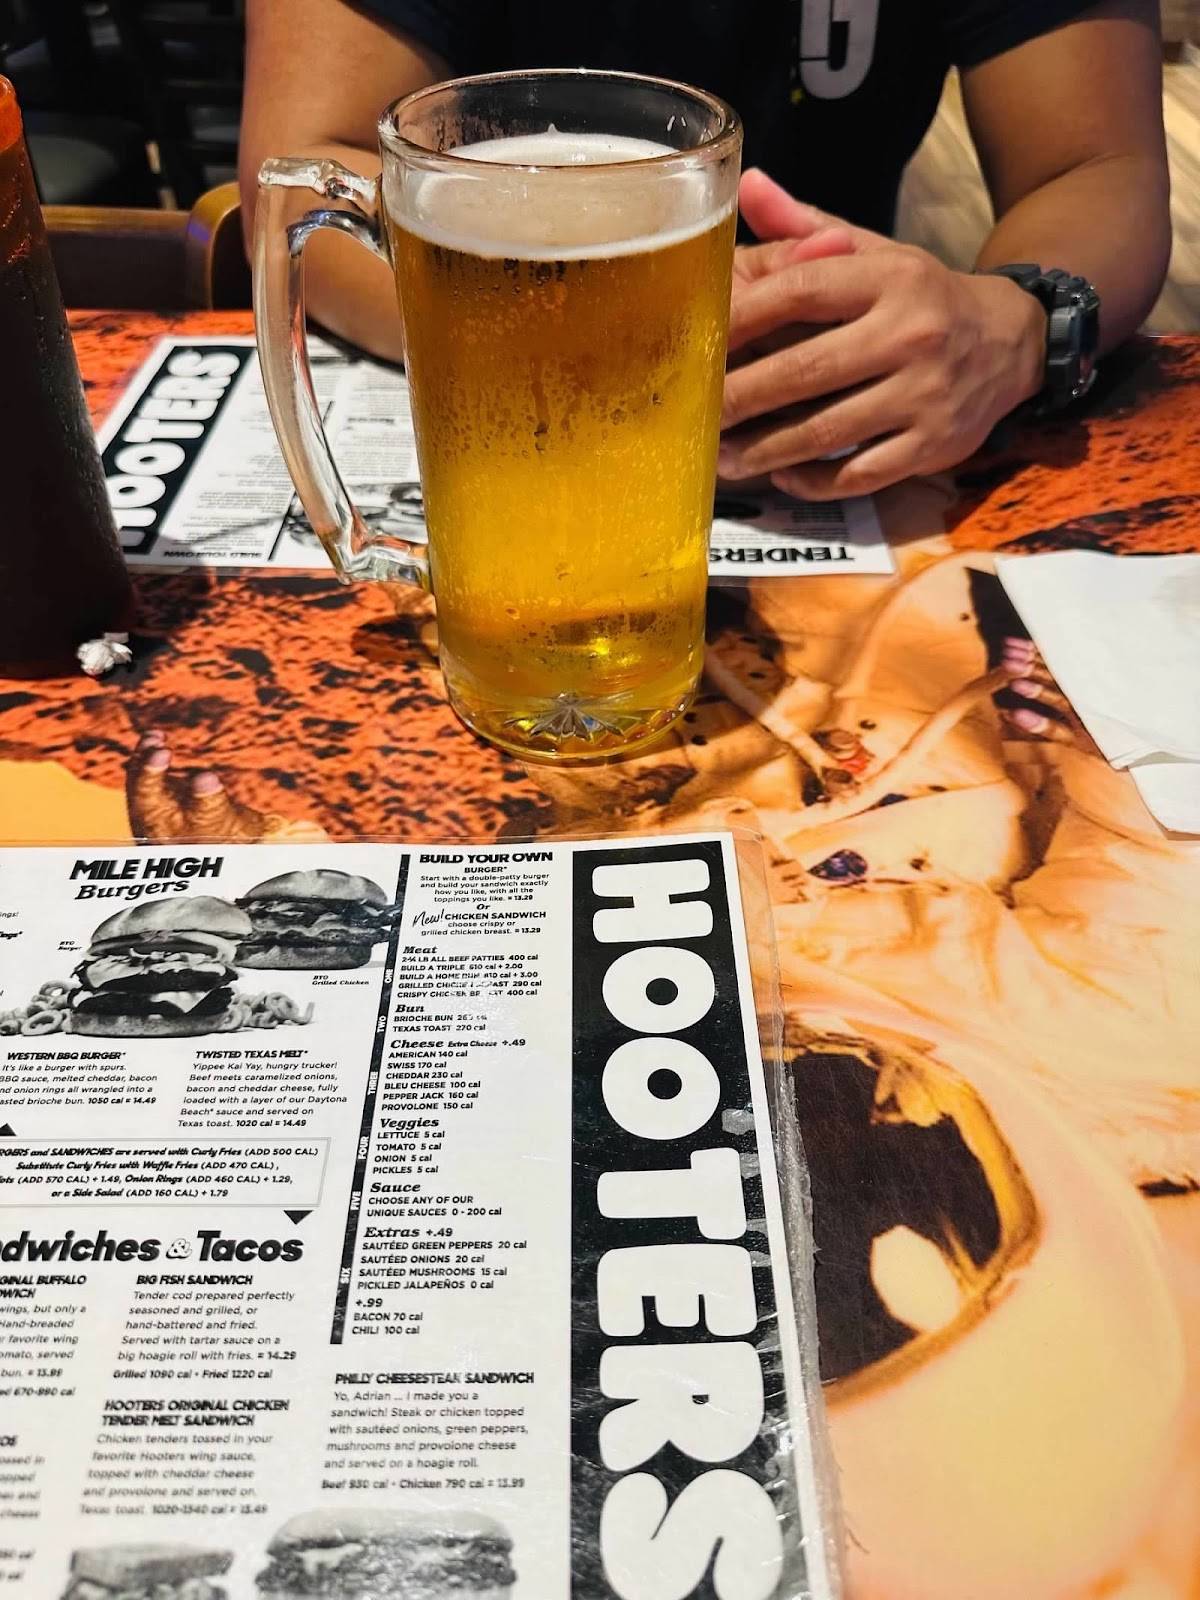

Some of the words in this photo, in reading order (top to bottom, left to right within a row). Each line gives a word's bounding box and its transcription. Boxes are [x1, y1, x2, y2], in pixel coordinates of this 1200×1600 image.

[710, 546, 855, 563] TENDERS
[419, 854, 464, 864] BUILD
[467, 854, 510, 864] YOUR
[512, 852, 553, 862] OWN
[69, 859, 141, 880] MILE
[142, 857, 224, 878] HIGH
[74, 880, 190, 900] Burgers
[412, 908, 444, 927] New!
[444, 912, 489, 920] CHICKEN
[491, 911, 546, 919] SANDWICH
[403, 946, 438, 954] Meat
[384, 968, 393, 984] ONE
[395, 1004, 424, 1012] Bun
[377, 1015, 387, 1033] TWO
[390, 1039, 444, 1049] Cheese
[502, 1038, 526, 1046] +.49
[7, 1052, 56, 1060] WESTERN
[56, 1052, 79, 1060] BBQ
[196, 1050, 242, 1059] TWISTED
[244, 1050, 277, 1059] TEXAS
[44, 1064, 76, 1072] burger
[193, 1063, 225, 1071] Yippee
[245, 1063, 263, 1071] Yay,
[266, 1062, 299, 1071] hungry
[431, 1071, 448, 1079] 230
[368, 1071, 378, 1095] THREE
[410, 1081, 446, 1089] CHEESE
[383, 1092, 418, 1100] PEPPER
[420, 1092, 444, 1100] JACK
[466, 1091, 479, 1099] cal
[381, 1103, 439, 1111] PROVOLONE
[380, 1117, 439, 1130] Veggies
[377, 1131, 420, 1139] LETTUCE
[432, 1130, 445, 1138] cal
[358, 1136, 369, 1160] FOUR
[376, 1143, 416, 1151] TOMATO
[428, 1142, 442, 1150] cal
[374, 1155, 406, 1163] ONION
[410, 1154, 417, 1162] 5
[419, 1154, 432, 1162] cal
[372, 1166, 412, 1174] PICKLES
[425, 1165, 439, 1173] cal
[370, 1182, 421, 1193] Sauce
[350, 1191, 361, 1210] FIVE
[368, 1196, 410, 1205] CHOOSE
[412, 1196, 434, 1204] ANY
[436, 1196, 450, 1204] OF
[452, 1195, 474, 1204] OUR
[367, 1209, 405, 1217] UNIQUE
[407, 1208, 447, 1217] SAUCES
[452, 1208, 459, 1216] 0
[467, 1207, 486, 1216] 200
[488, 1207, 502, 1215] cal
[363, 1227, 420, 1238] Extras
[426, 1227, 453, 1237] +.49
[592, 858, 784, 1600] HOOTERS
[0, 1230, 161, 1262] dwiches
[165, 1239, 189, 1260] &
[197, 1230, 304, 1262] Tacos
[362, 1240, 409, 1250] SAUTÉED
[411, 1241, 446, 1250] GREEN
[448, 1241, 493, 1250] PEPPERS
[498, 1241, 511, 1249] 20
[513, 1240, 527, 1249] cal
[360, 1254, 408, 1264] SAUTÉED
[410, 1255, 450, 1264] ONIONS
[455, 1255, 468, 1263] 20
[471, 1255, 485, 1263] cal
[340, 1267, 351, 1284] SIX
[359, 1267, 406, 1277] SAUTÉED
[409, 1267, 475, 1276] MUSHROOMS
[481, 1267, 491, 1276] 15
[493, 1267, 507, 1276] cal
[136, 1275, 158, 1285] BIG
[159, 1275, 185, 1285] FISH
[186, 1275, 253, 1285] SANDWICH
[357, 1281, 401, 1290] PICKLED
[403, 1278, 465, 1289] JALAPEÑOS
[470, 1280, 477, 1289] 0
[480, 1280, 494, 1289] cal
[134, 1291, 169, 1300] Tender
[172, 1291, 193, 1300] cod
[195, 1291, 245, 1301] prepared
[246, 1291, 295, 1302] perfectly
[355, 1298, 383, 1307] +.99
[353, 1312, 390, 1321] BACON
[394, 1312, 406, 1321] 70
[408, 1312, 423, 1321] cal
[352, 1326, 379, 1335] CHILI
[384, 1326, 403, 1335] 100
[405, 1326, 420, 1334] cal
[335, 1373, 373, 1384] PHILLY
[464, 1372, 534, 1384] SANDWICH
[331, 1408, 387, 1417] sandwich!
[391, 1407, 422, 1417] Steak
[424, 1409, 436, 1417] or
[439, 1407, 481, 1417] chicken
[484, 1407, 524, 1418] topped
